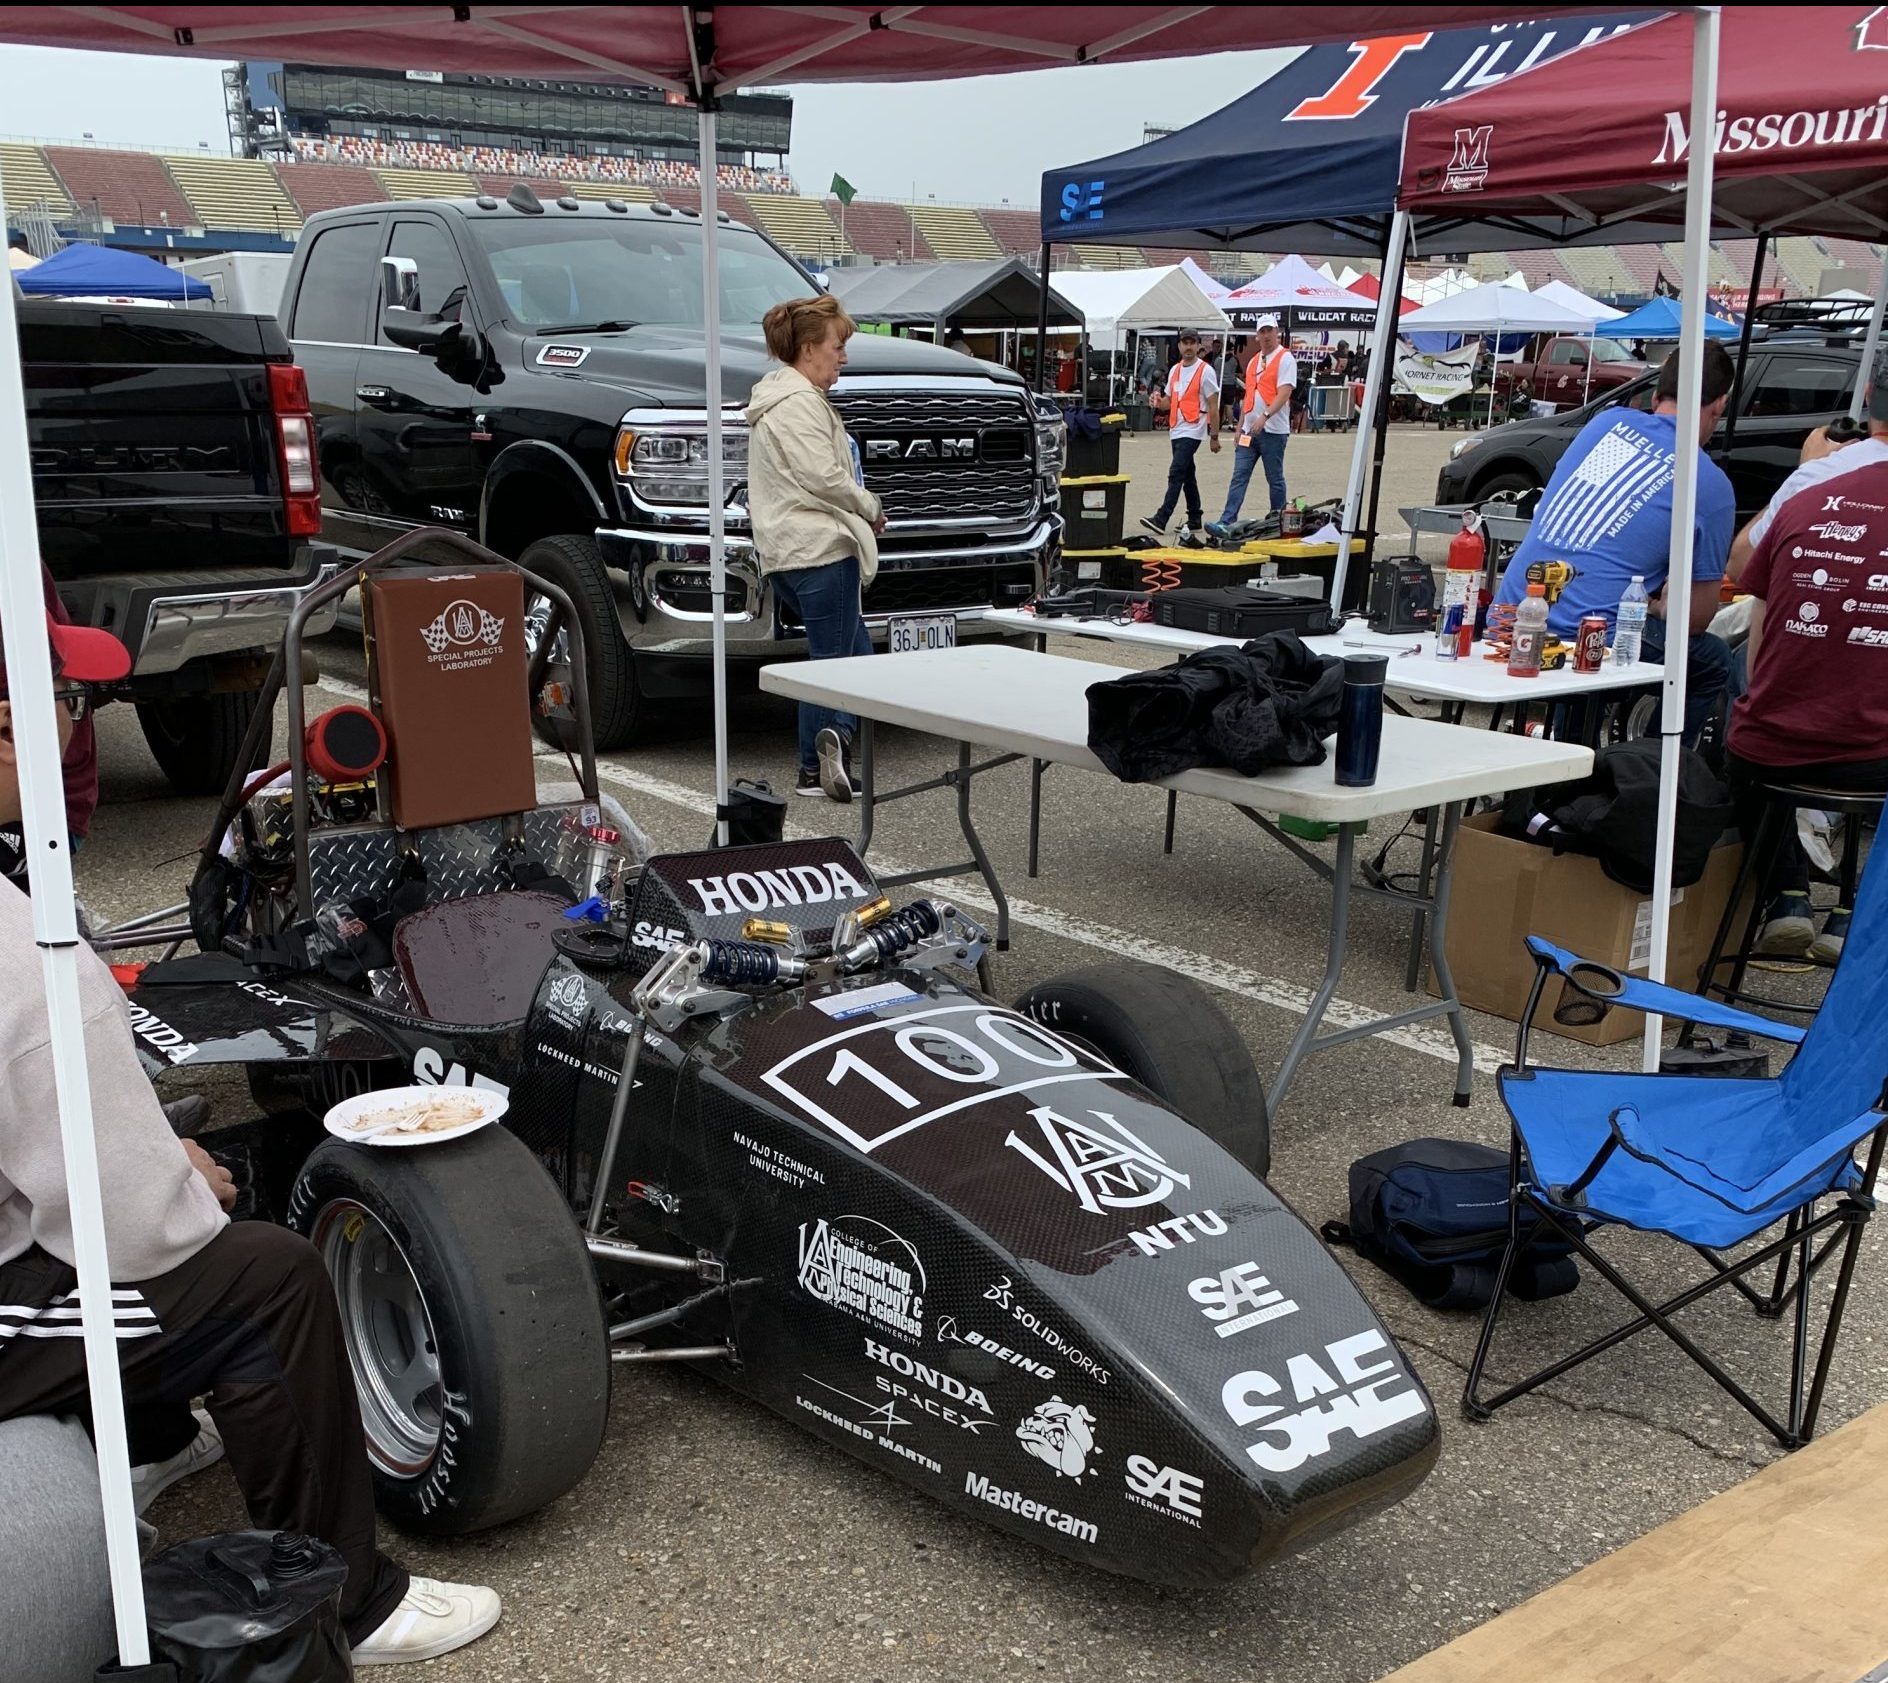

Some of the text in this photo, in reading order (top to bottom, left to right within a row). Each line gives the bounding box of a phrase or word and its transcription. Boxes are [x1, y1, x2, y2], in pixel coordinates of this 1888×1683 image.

[1298, 312, 1346, 321] WILDCAT
[866, 439, 974, 458] RAM
[1611, 421, 1676, 465] MUELLE
[1607, 509, 1633, 537] MADE
[1631, 501, 1643, 512] IN
[1804, 549, 1865, 564] Hitachi Energy
[427, 645, 504, 662] SPECIAL PROJECTS
[893, 628, 919, 652] 36J
[1517, 634, 1533, 652] G
[440, 657, 493, 671] LABORATORY
[688, 862, 868, 916] HONDA
[631, 922, 685, 950] SAE
[128, 1000, 199, 1064] ONDA
[537, 1042, 619, 1085] LOCKHEED MARTIN
[826, 1014, 1078, 1109] 100
[733, 1131, 825, 1185] NAVAJO TECHNICAL
[749, 1154, 805, 1189] UNIVERSITY
[831, 1227, 878, 1253] COLLEGE OF
[1127, 1209, 1228, 1256] NTU
[829, 1234, 914, 1296] Engineering,
[835, 1260, 924, 1319] Technology &
[1187, 1261, 1284, 1321] SAE
[855, 1313, 871, 1324] A&M
[873, 1321, 921, 1347] UNIVERSITY
[869, 1297, 922, 1338] Sciences
[964, 1331, 1056, 1380] BOEING
[1012, 1305, 1111, 1385] SOLIDWORKS
[864, 1337, 994, 1415] HONDA
[875, 1375, 1000, 1435] SPACEX
[1222, 1328, 1426, 1472] SAE
[796, 1395, 942, 1474] LOCKHEED MARTIN
[964, 1471, 1099, 1543] Mastercam
[1125, 1454, 1204, 1518] SAE
[1125, 1491, 1202, 1529] INTERNATIONAL
